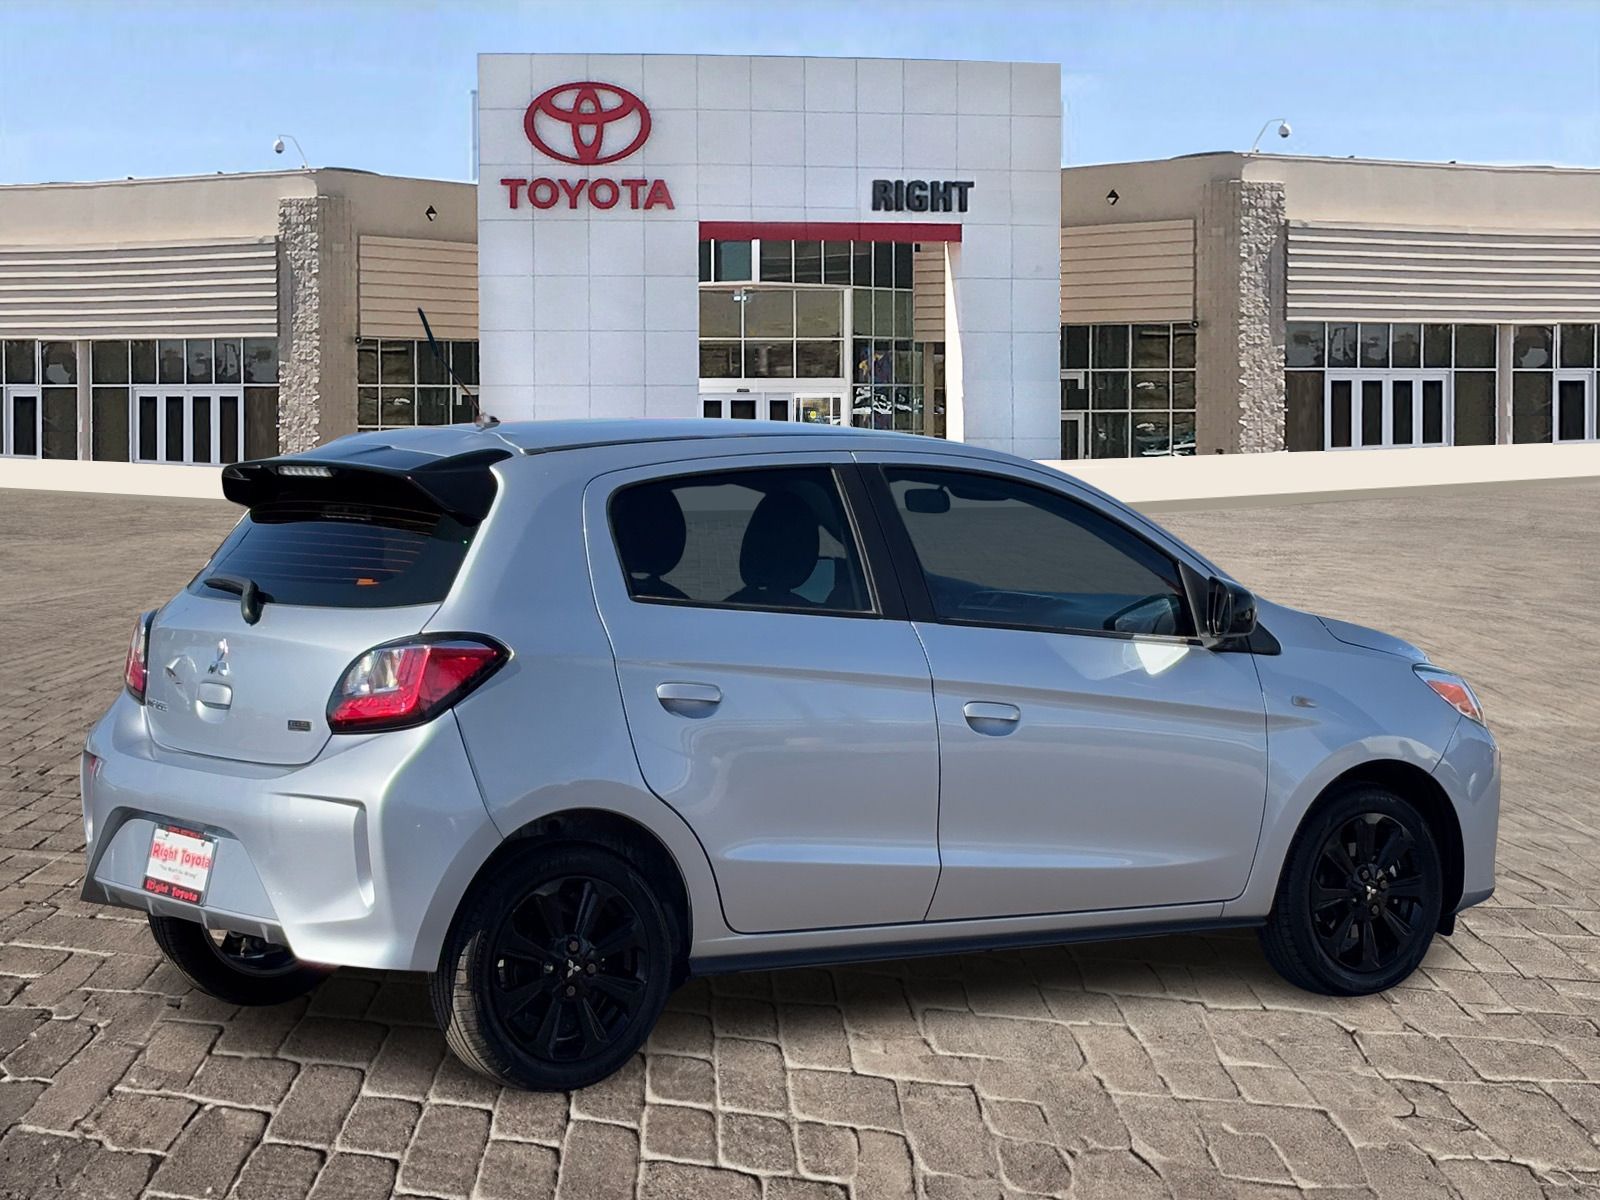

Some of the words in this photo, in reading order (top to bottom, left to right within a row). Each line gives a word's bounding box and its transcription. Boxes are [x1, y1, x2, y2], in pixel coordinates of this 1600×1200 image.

[500, 178, 675, 210] TOYOTA
[872, 179, 975, 212] RIGHT
[152, 842, 178, 863] Right
[180, 848, 212, 869] Toyota
[146, 880, 169, 894] Right
[171, 886, 198, 902] Toyota
